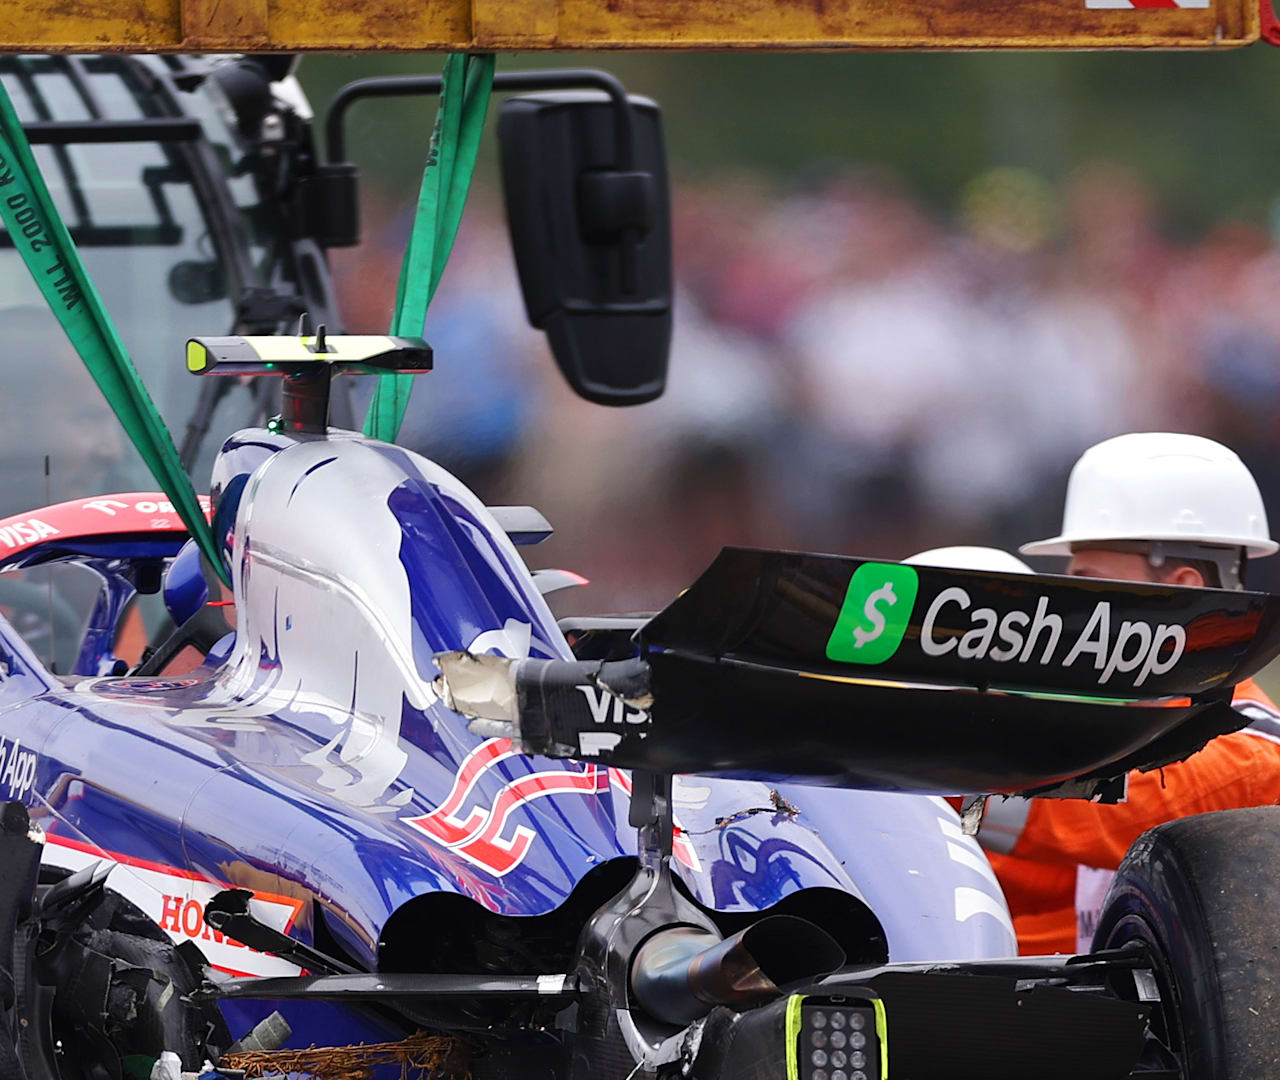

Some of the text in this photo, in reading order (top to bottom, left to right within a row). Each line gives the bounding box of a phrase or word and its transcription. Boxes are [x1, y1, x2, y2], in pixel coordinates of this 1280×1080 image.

[6, 193, 53, 252] 2000
[46, 254, 84, 311] WLL
[920, 587, 1063, 664] Cash
[1062, 601, 1186, 687] App
[576, 685, 653, 724] VI
[2, 738, 37, 801] App
